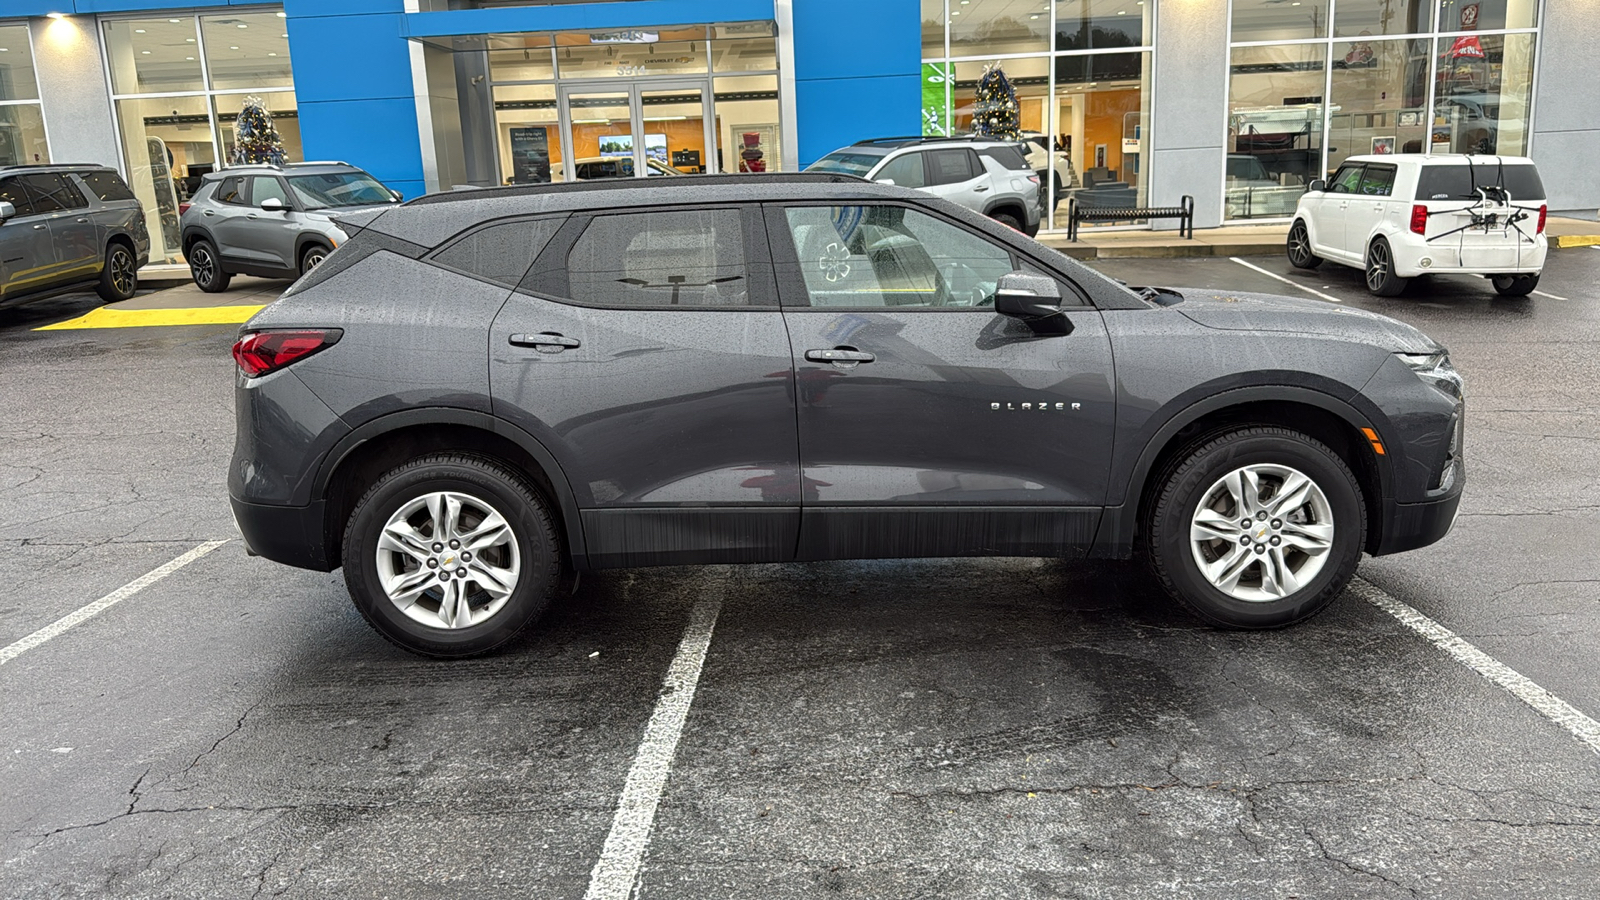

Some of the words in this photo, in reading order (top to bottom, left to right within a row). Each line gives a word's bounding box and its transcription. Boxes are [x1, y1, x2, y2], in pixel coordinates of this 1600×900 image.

[616, 65, 646, 76] 3514
[990, 402, 1081, 410] BLAZER
[442, 470, 486, 485] TOURING
